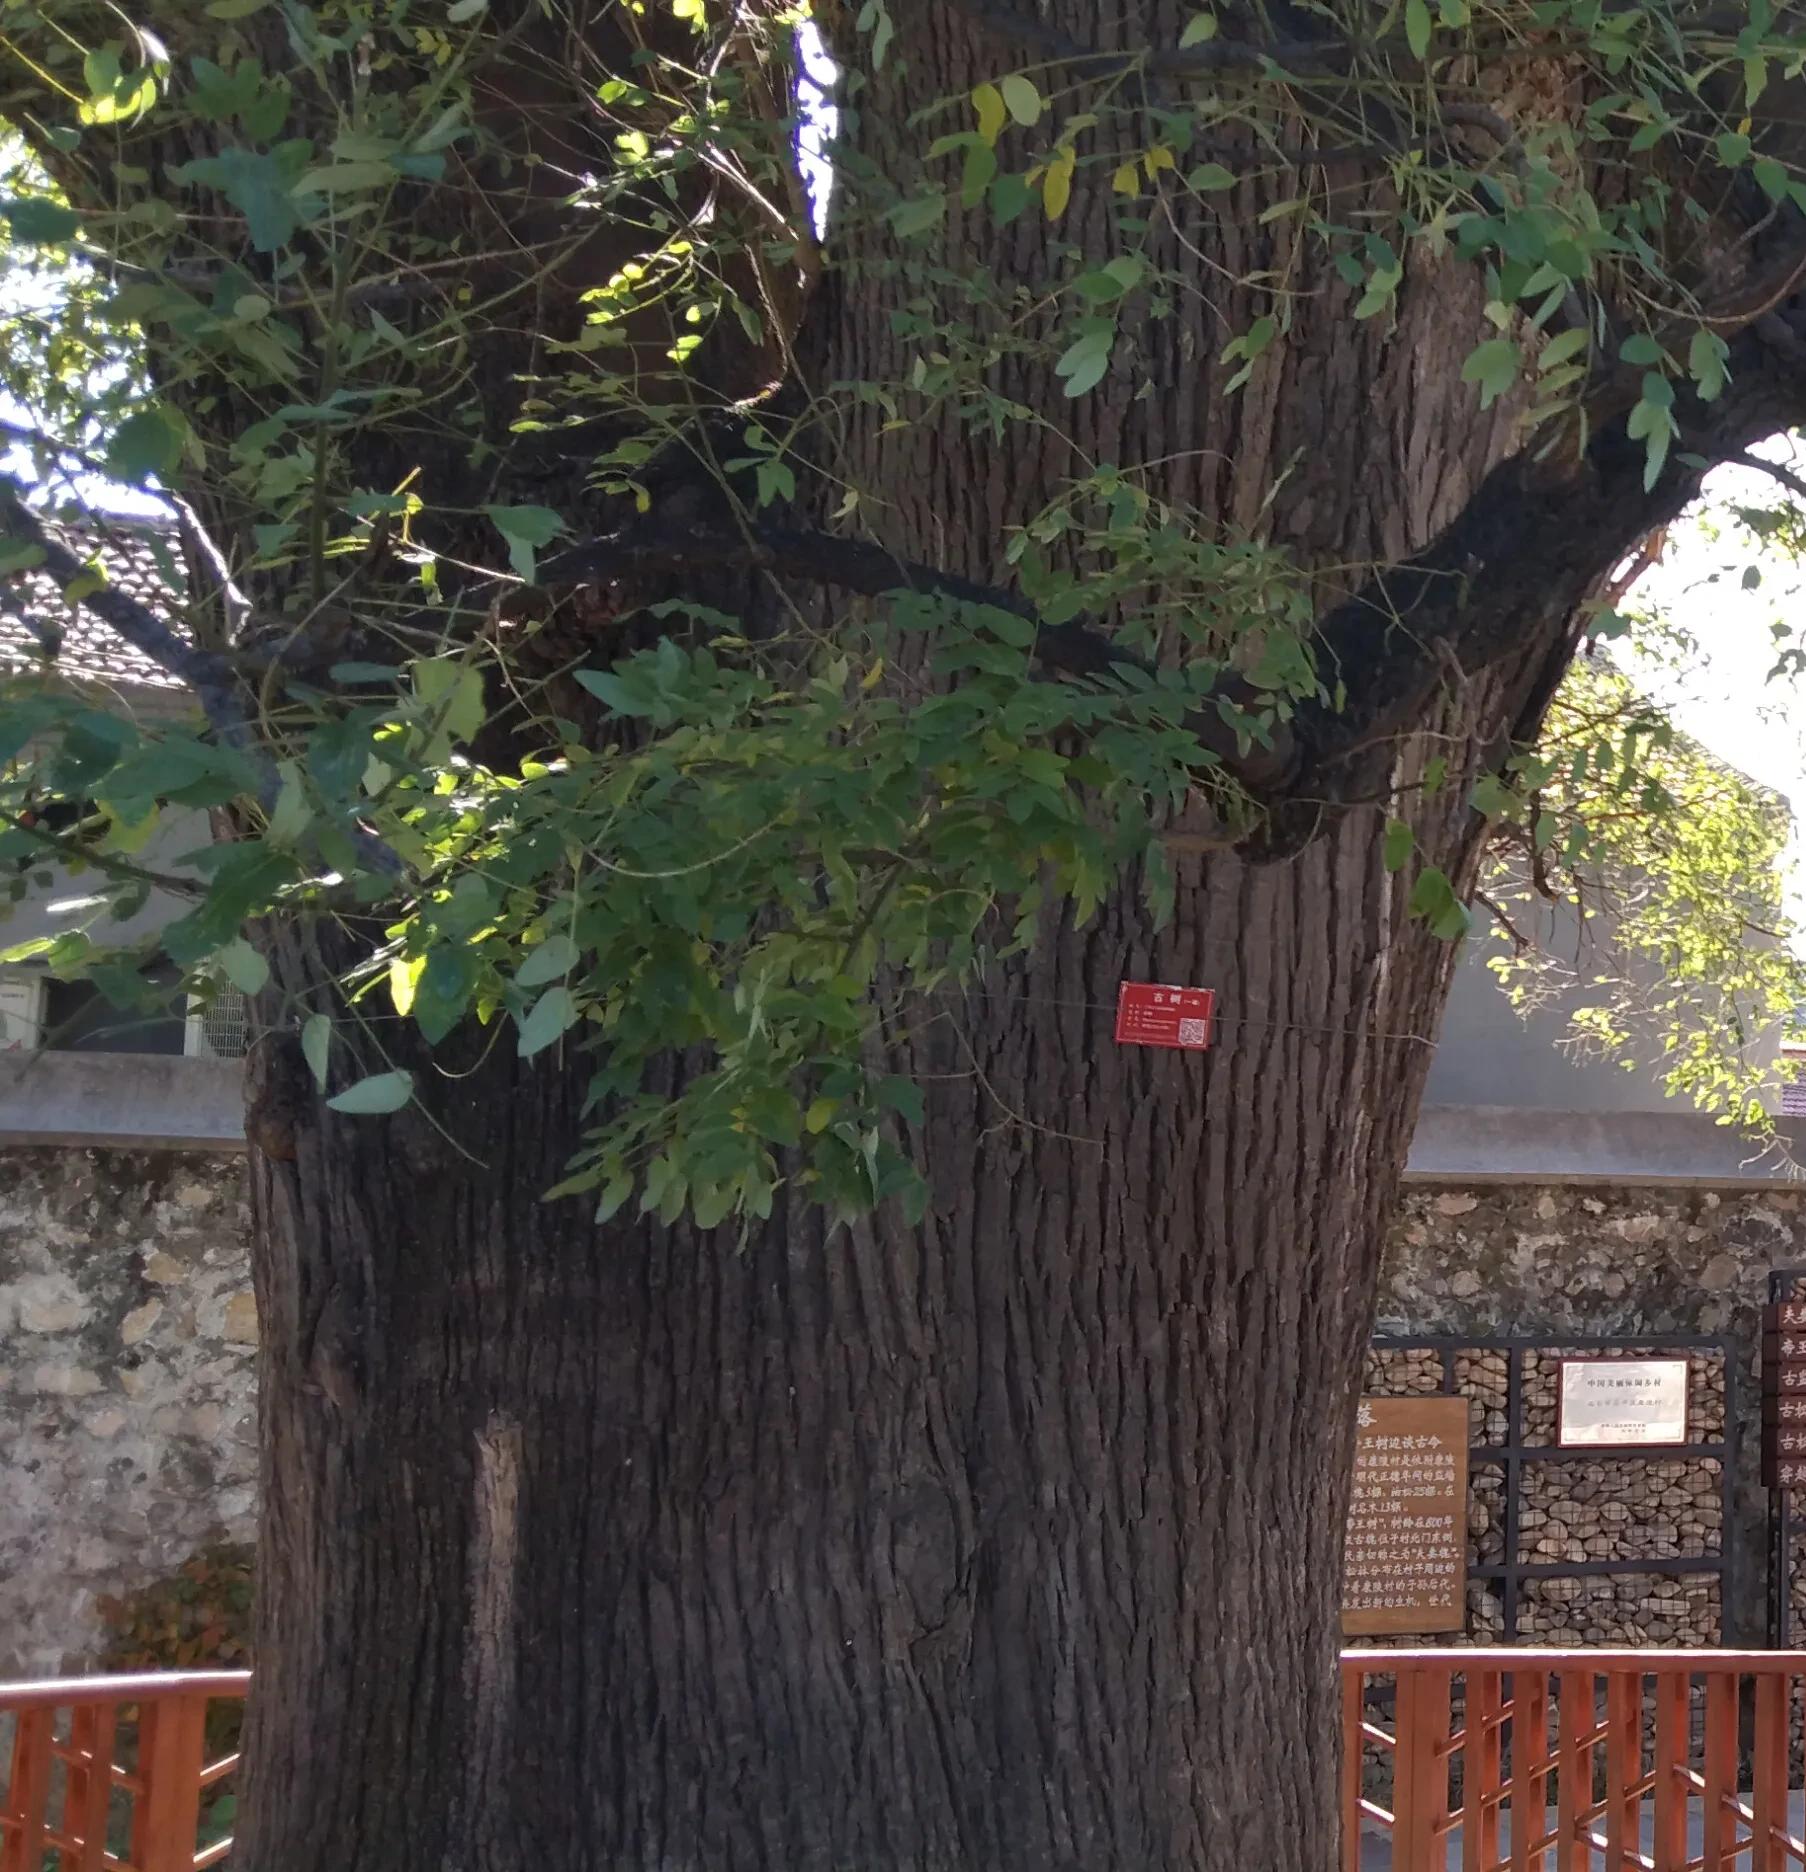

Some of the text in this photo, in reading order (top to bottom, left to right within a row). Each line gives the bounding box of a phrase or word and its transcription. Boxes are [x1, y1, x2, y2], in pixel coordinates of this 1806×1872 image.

[1356, 1434, 1442, 1450] 王树边谈古今
